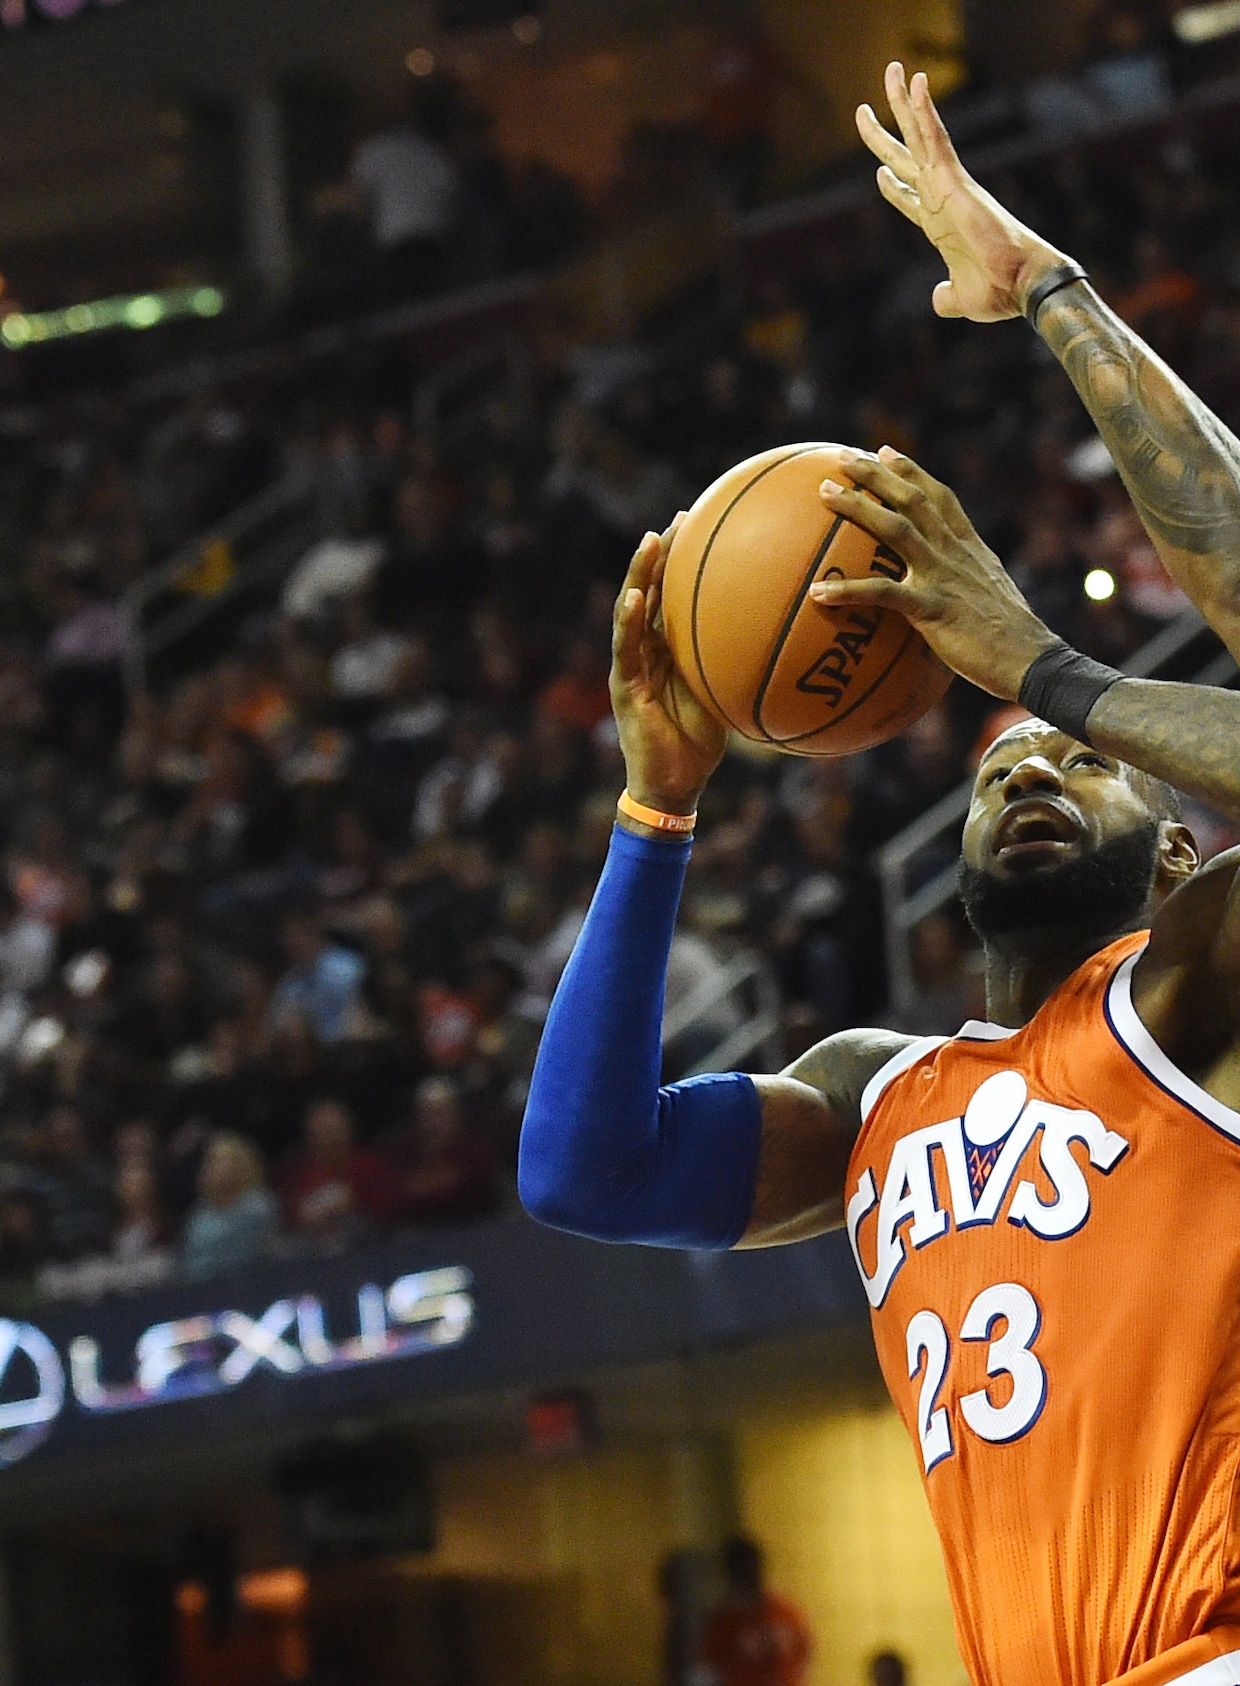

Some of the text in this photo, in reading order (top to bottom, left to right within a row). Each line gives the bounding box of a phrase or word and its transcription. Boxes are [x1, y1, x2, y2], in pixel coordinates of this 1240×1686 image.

[846, 1070, 1129, 1309] CAVS
[69, 1264, 475, 1414] LEXUS
[905, 1282, 1047, 1476] 23
